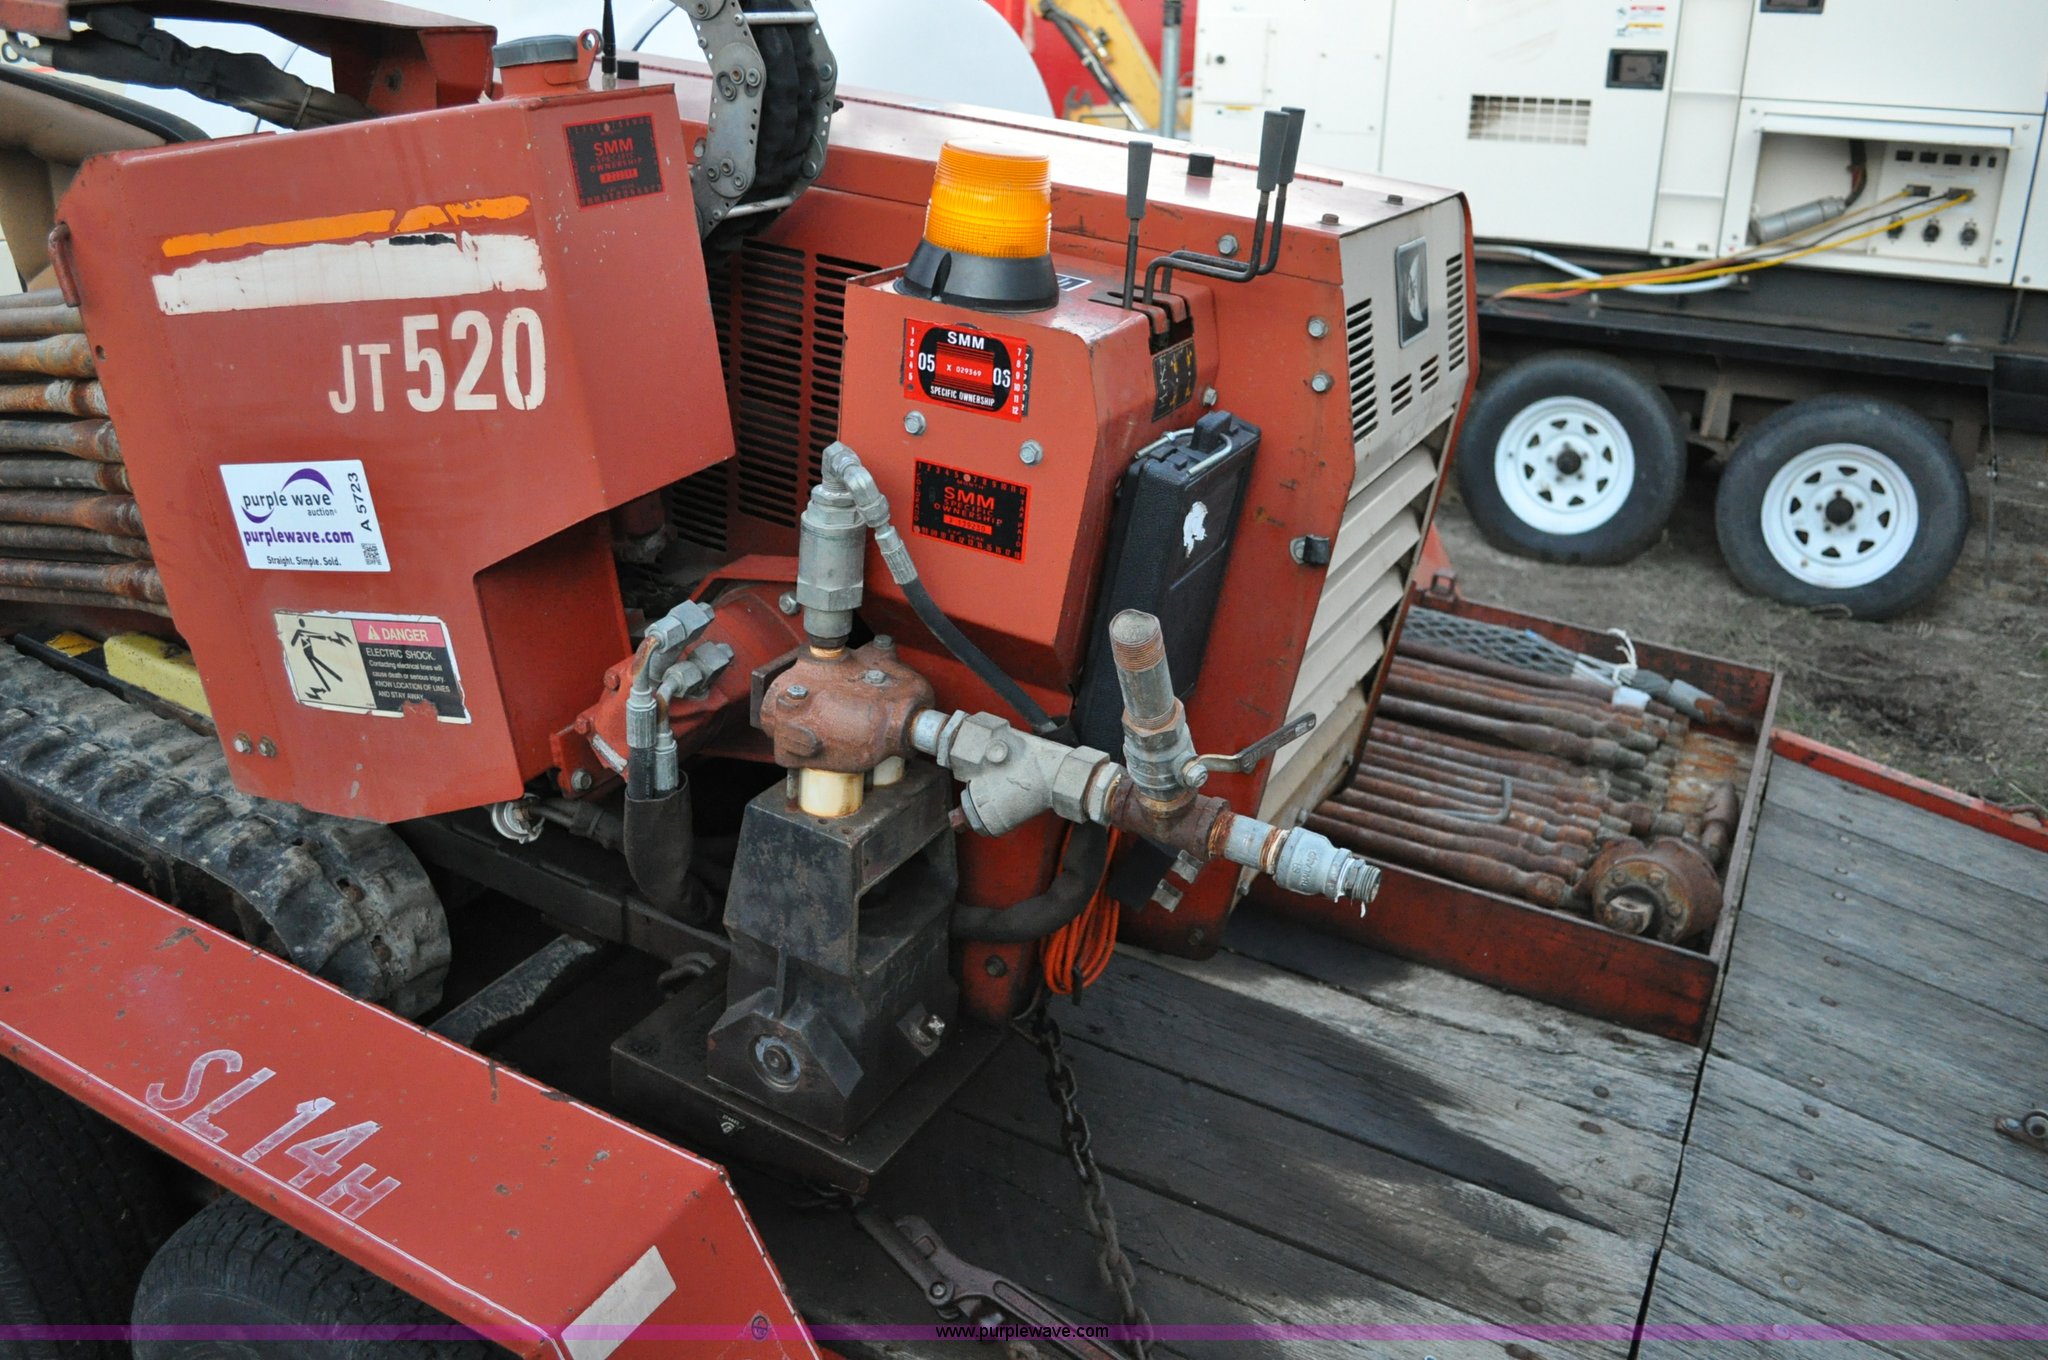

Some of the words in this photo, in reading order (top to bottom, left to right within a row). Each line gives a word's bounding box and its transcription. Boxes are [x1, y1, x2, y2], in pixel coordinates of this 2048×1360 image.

[593, 137, 634, 156] SMM
[947, 331, 985, 350] SMM
[918, 352, 935, 372] 05
[1014, 383, 1020, 392] 10
[930, 386, 957, 399] SPECIFIC
[959, 393, 995, 407] OWNERSHIP
[1014, 395, 1019, 403] 11
[1012, 406, 1019, 415] 12
[243, 492, 288, 509] purple
[291, 493, 331, 506] wave
[348, 472, 368, 514] 5723
[944, 486, 995, 510] SMM
[308, 508, 334, 516] auction
[934, 502, 1003, 525] OWNERSHIP
[944, 499, 994, 516] SPECIFIC
[361, 520, 372, 532] A
[243, 527, 354, 546] purplewave.com
[267, 556, 295, 567] Straight.
[296, 557, 322, 568] Simple.
[323, 557, 341, 566] Sold.
[382, 627, 429, 642] DANGER
[366, 648, 403, 659] ELECTRIC
[369, 660, 397, 670] Contacting
[393, 682, 423, 690] LOCATION
[146, 1050, 277, 1143] SL
